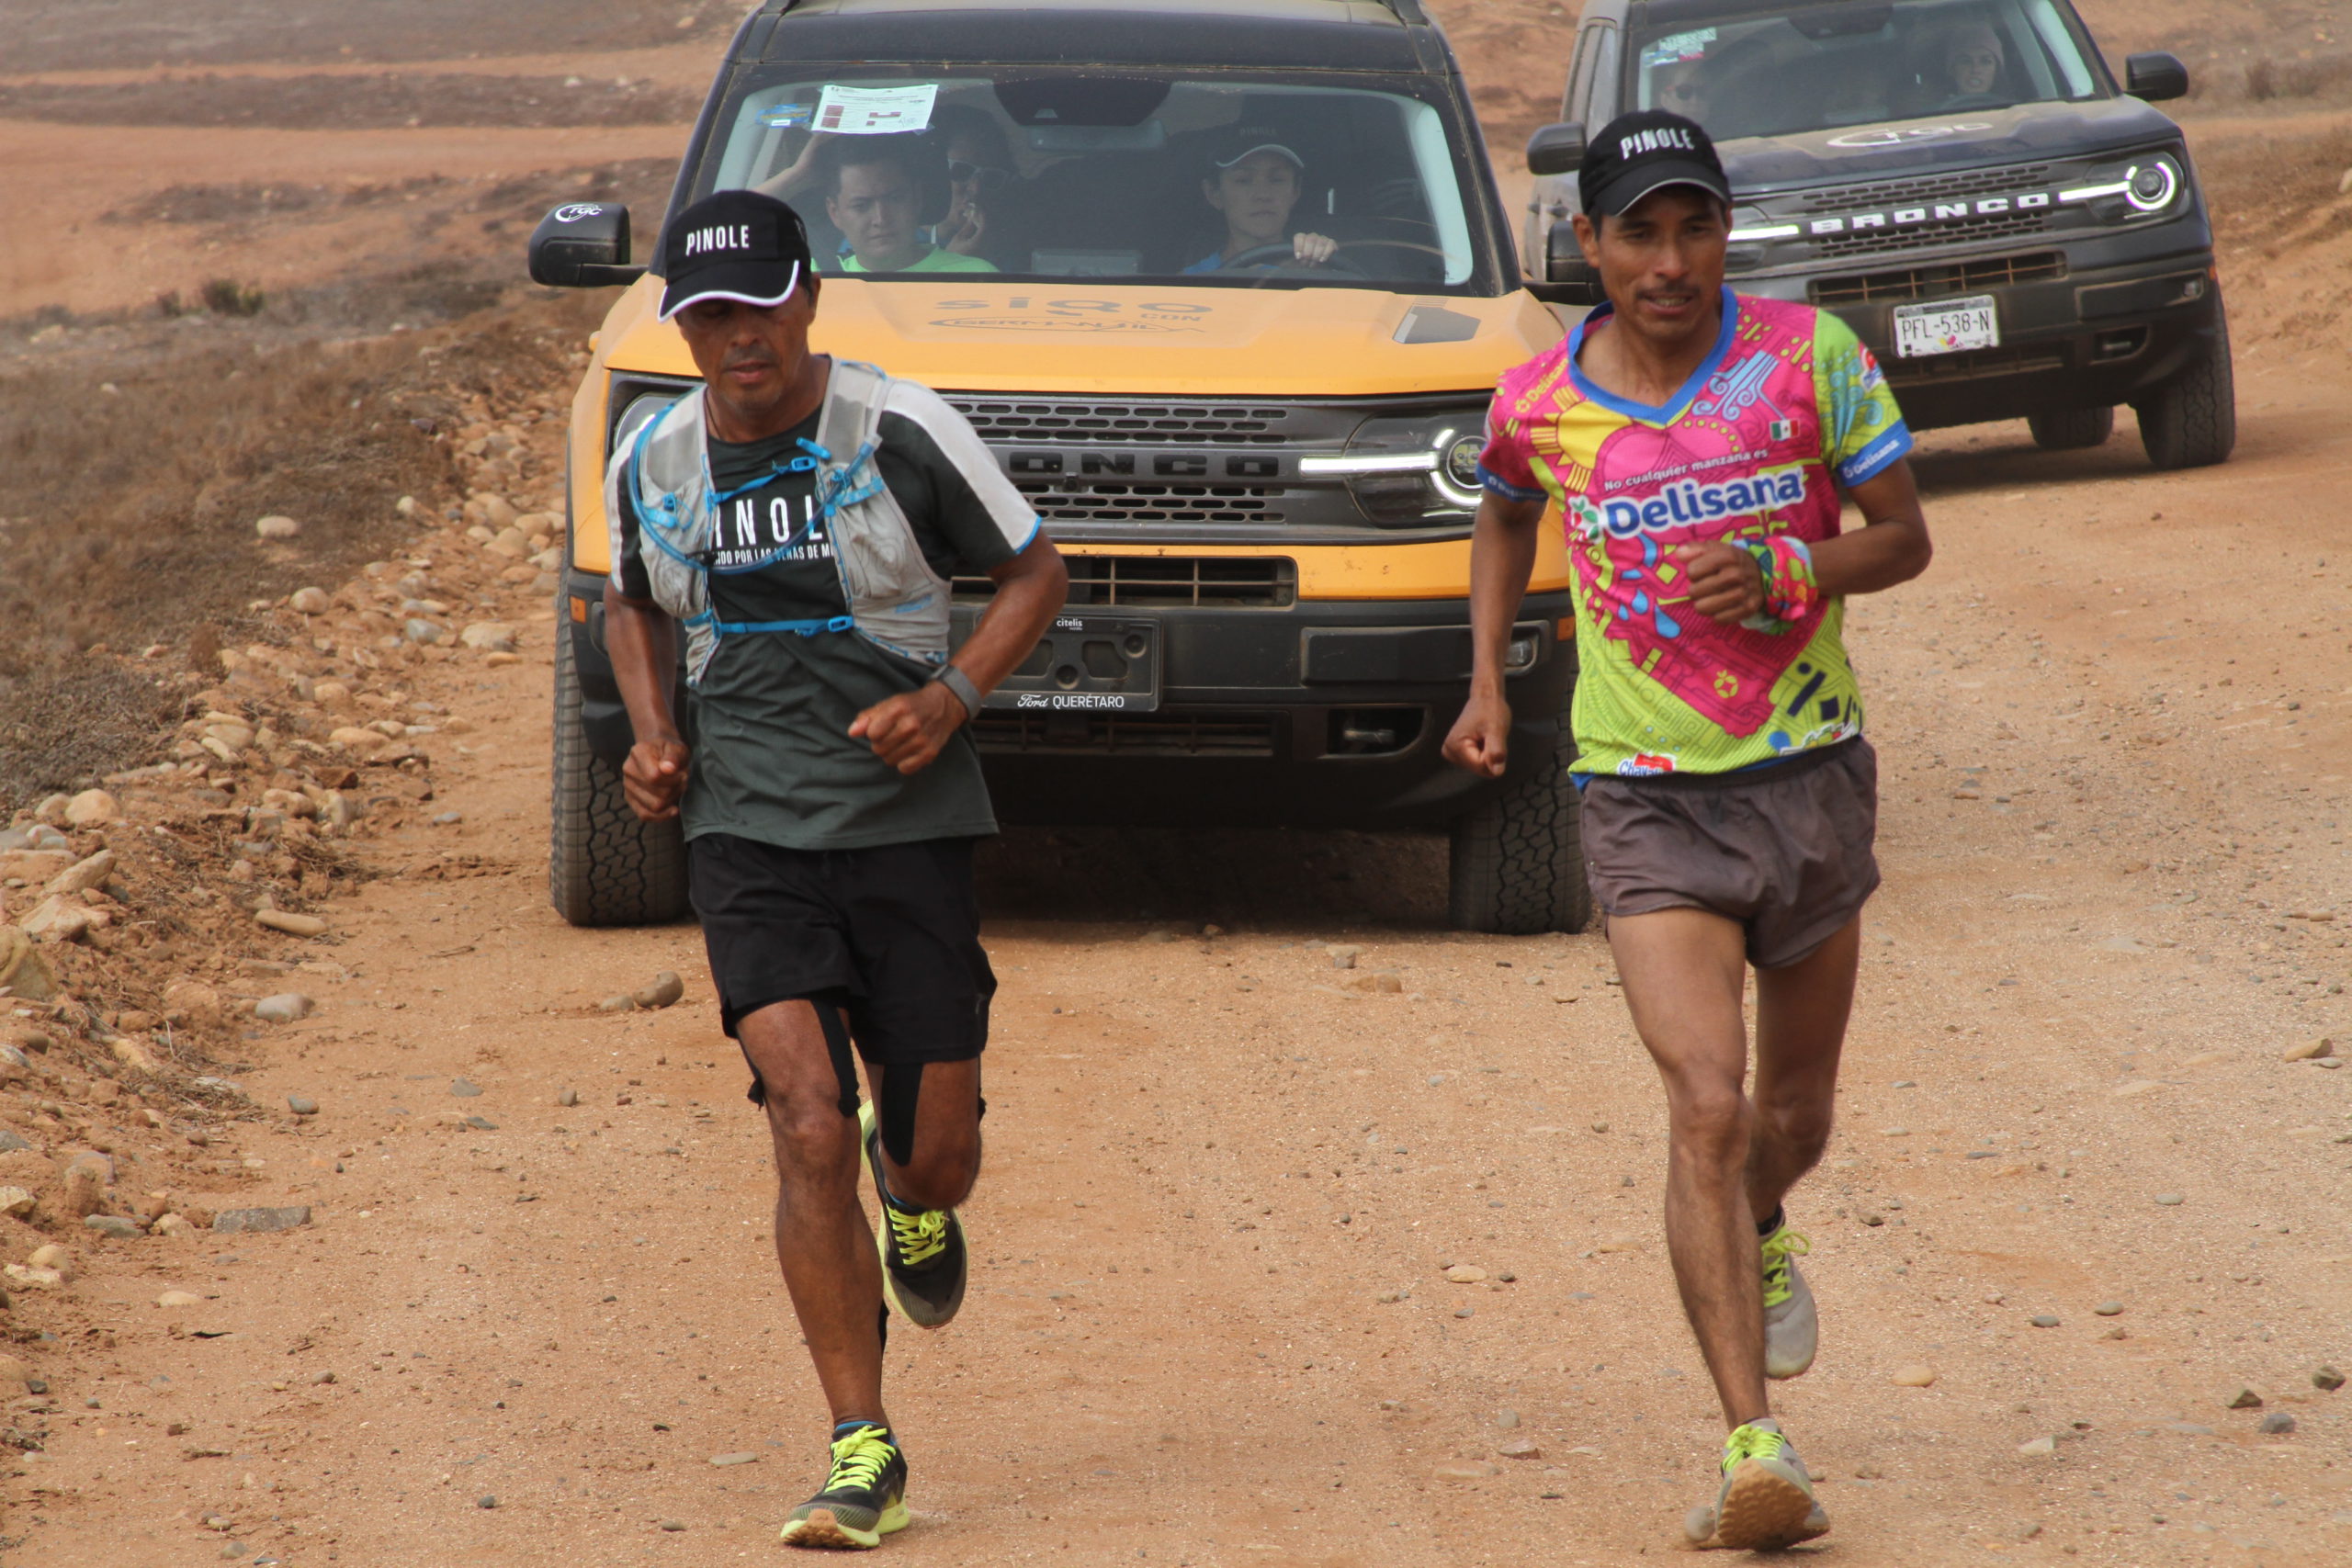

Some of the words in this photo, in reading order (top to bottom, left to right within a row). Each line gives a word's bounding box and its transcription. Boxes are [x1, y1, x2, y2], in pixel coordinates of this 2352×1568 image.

[1620, 128, 1695, 160] PINOLE
[1810, 192, 2049, 234] BRONCO
[685, 224, 750, 256] PINOLE
[1902, 310, 1990, 342] PFL-538-N
[1009, 451, 1279, 478] ONCO
[1604, 479, 1622, 491] No
[1625, 464, 1688, 488] cualquier
[1691, 453, 1750, 472] manzana
[1754, 448, 1769, 459] es
[1605, 471, 1804, 536] Delisana
[715, 494, 823, 548] INOL
[735, 548, 752, 564] POR
[807, 544, 819, 559] DE
[1057, 618, 1083, 627] citelis
[1017, 694, 1049, 708] Ford
[1052, 694, 1125, 710] QUERÉTARO
